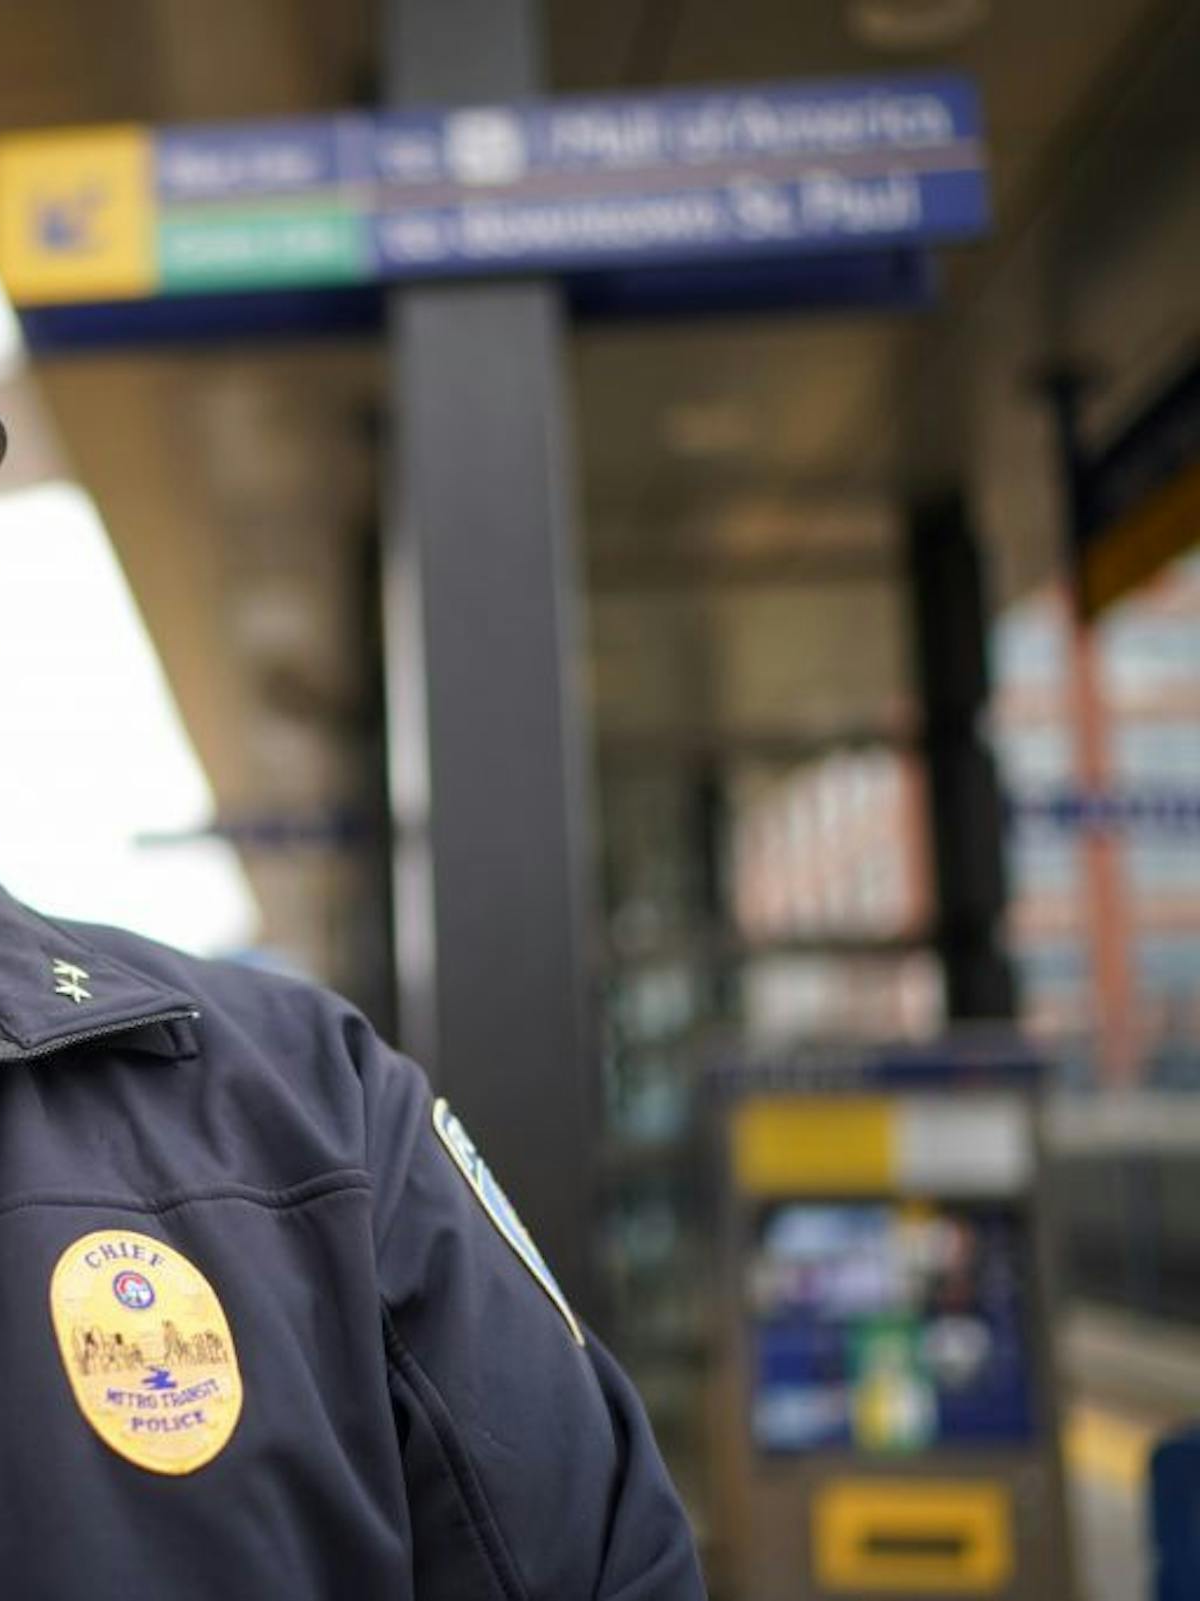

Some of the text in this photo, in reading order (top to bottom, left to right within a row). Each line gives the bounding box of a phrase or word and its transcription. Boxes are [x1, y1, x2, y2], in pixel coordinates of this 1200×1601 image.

[84, 1241, 165, 1269] CHIEF
[106, 1377, 220, 1409] METRO TRANSIT
[130, 1410, 206, 1433] POLICE
